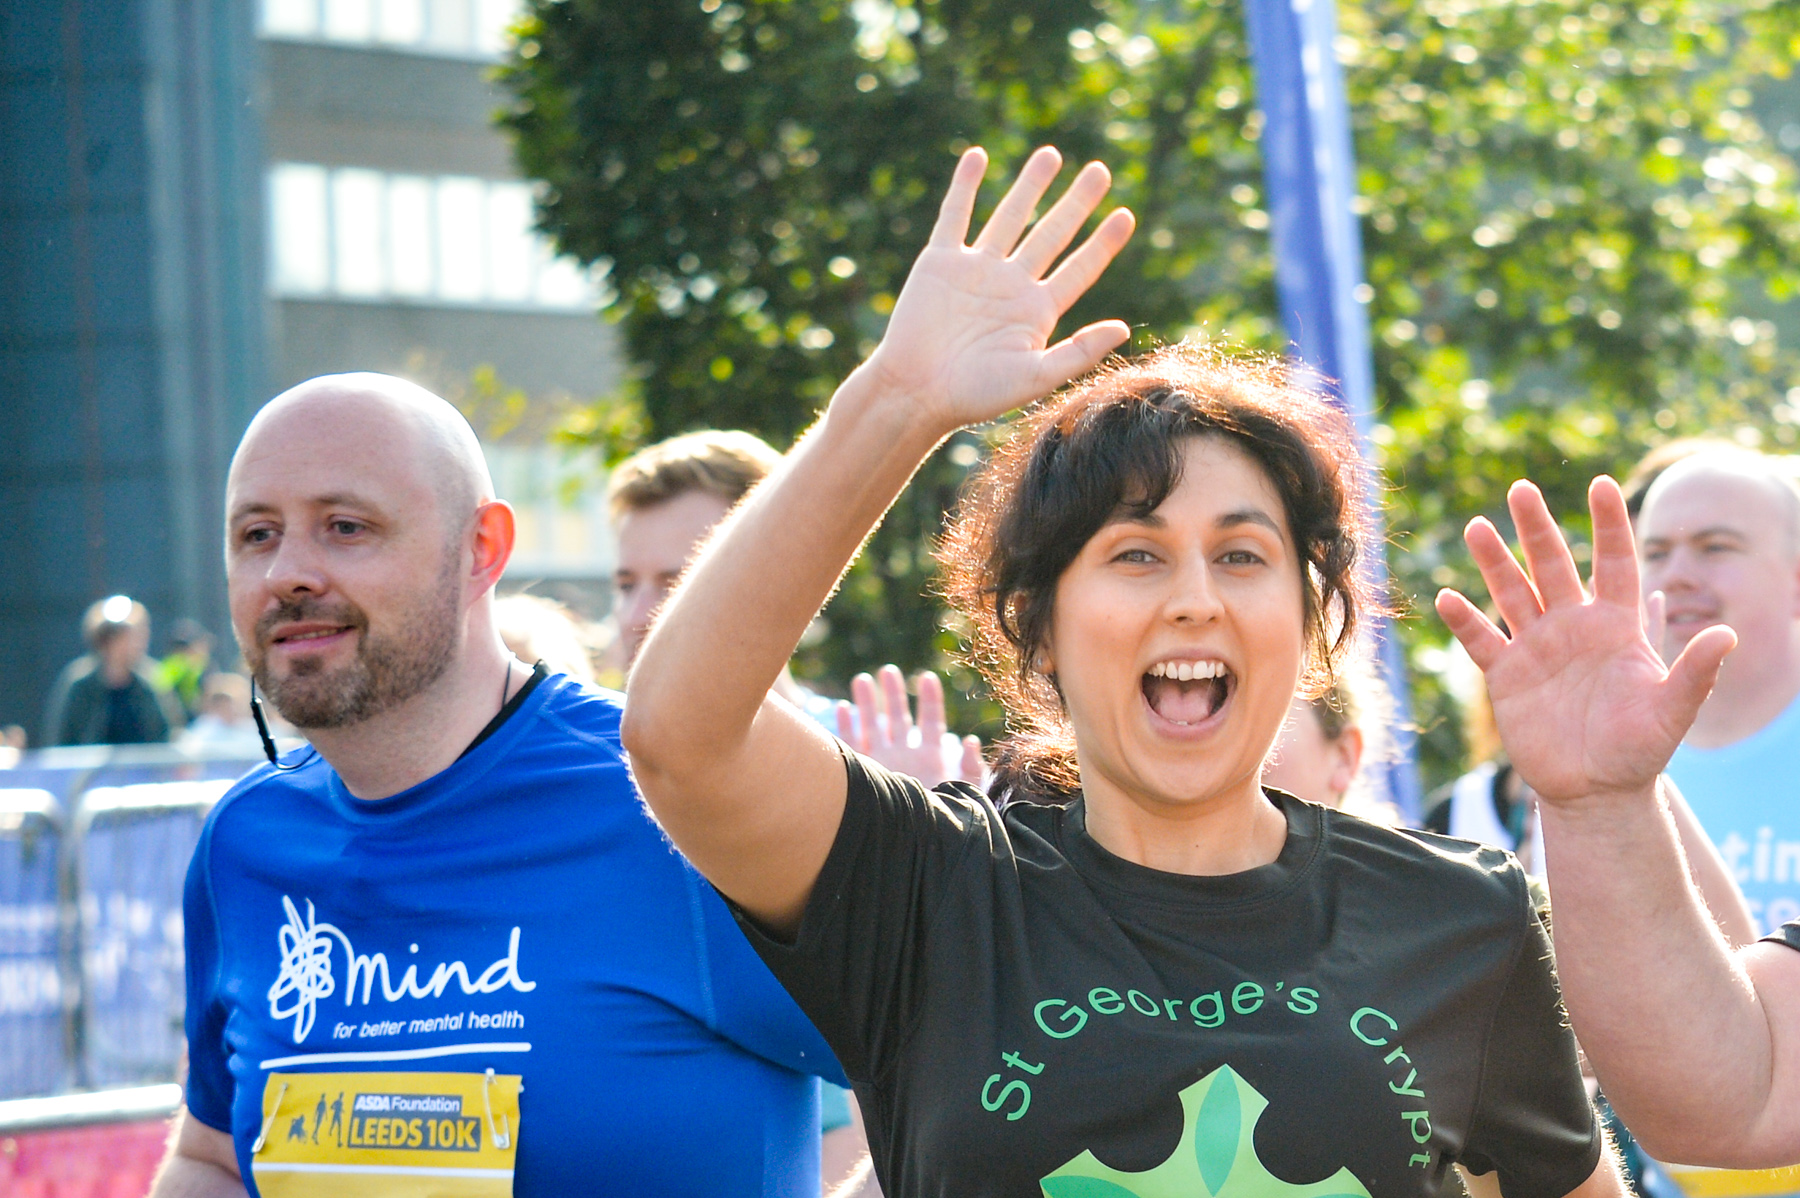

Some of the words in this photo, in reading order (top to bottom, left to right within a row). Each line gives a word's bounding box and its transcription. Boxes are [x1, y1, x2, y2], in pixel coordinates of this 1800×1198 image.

[345, 926, 537, 1006] mind
[333, 1021, 356, 1040] for
[358, 1019, 406, 1038] better
[408, 1012, 464, 1034] mental
[467, 1009, 525, 1030] health
[980, 1050, 1046, 1121] St
[1033, 980, 1320, 1040] George's
[1348, 1006, 1433, 1169] Crypt
[354, 1094, 391, 1111] ASDA
[392, 1096, 461, 1113] Foundation
[350, 1117, 423, 1147] LEEDS
[427, 1119, 478, 1149] 10K
